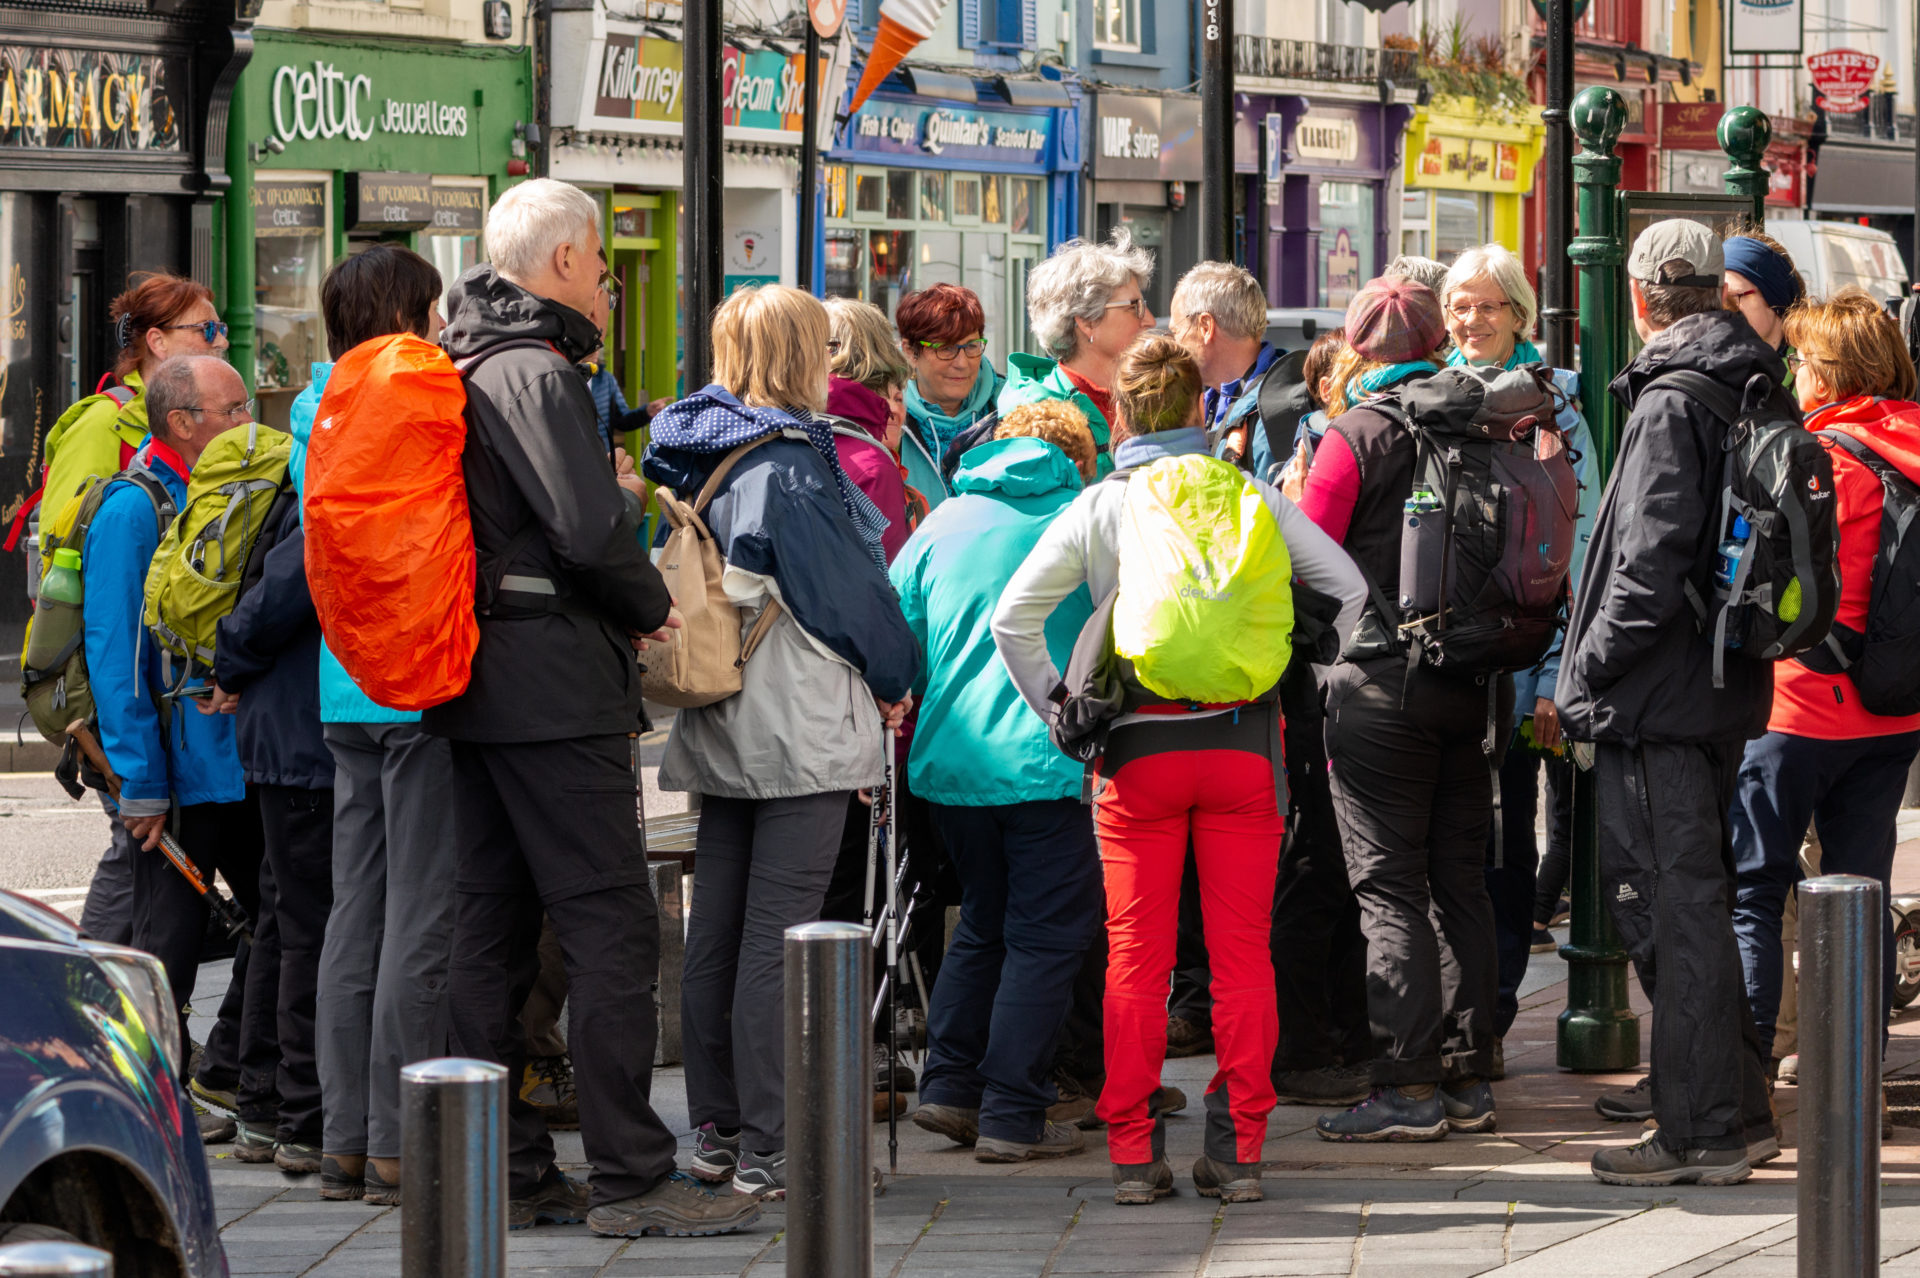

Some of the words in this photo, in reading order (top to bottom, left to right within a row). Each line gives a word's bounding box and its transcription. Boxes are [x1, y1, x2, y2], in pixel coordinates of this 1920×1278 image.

[602, 45, 682, 114] Killarney
[724, 57, 774, 111] Cream
[776, 63, 805, 114] Sho
[1811, 53, 1876, 70] JULIE'S
[0, 68, 145, 131] ARMACY
[860, 114, 879, 137] Fish
[881, 116, 889, 138] &
[891, 117, 915, 146] Chips
[923, 112, 989, 155] Quinlan's
[995, 126, 1028, 149] Seafood
[1030, 129, 1046, 150] Bar
[1103, 116, 1132, 158] VAPE
[1133, 126, 1159, 159] store
[1180, 583, 1233, 603] deuter
